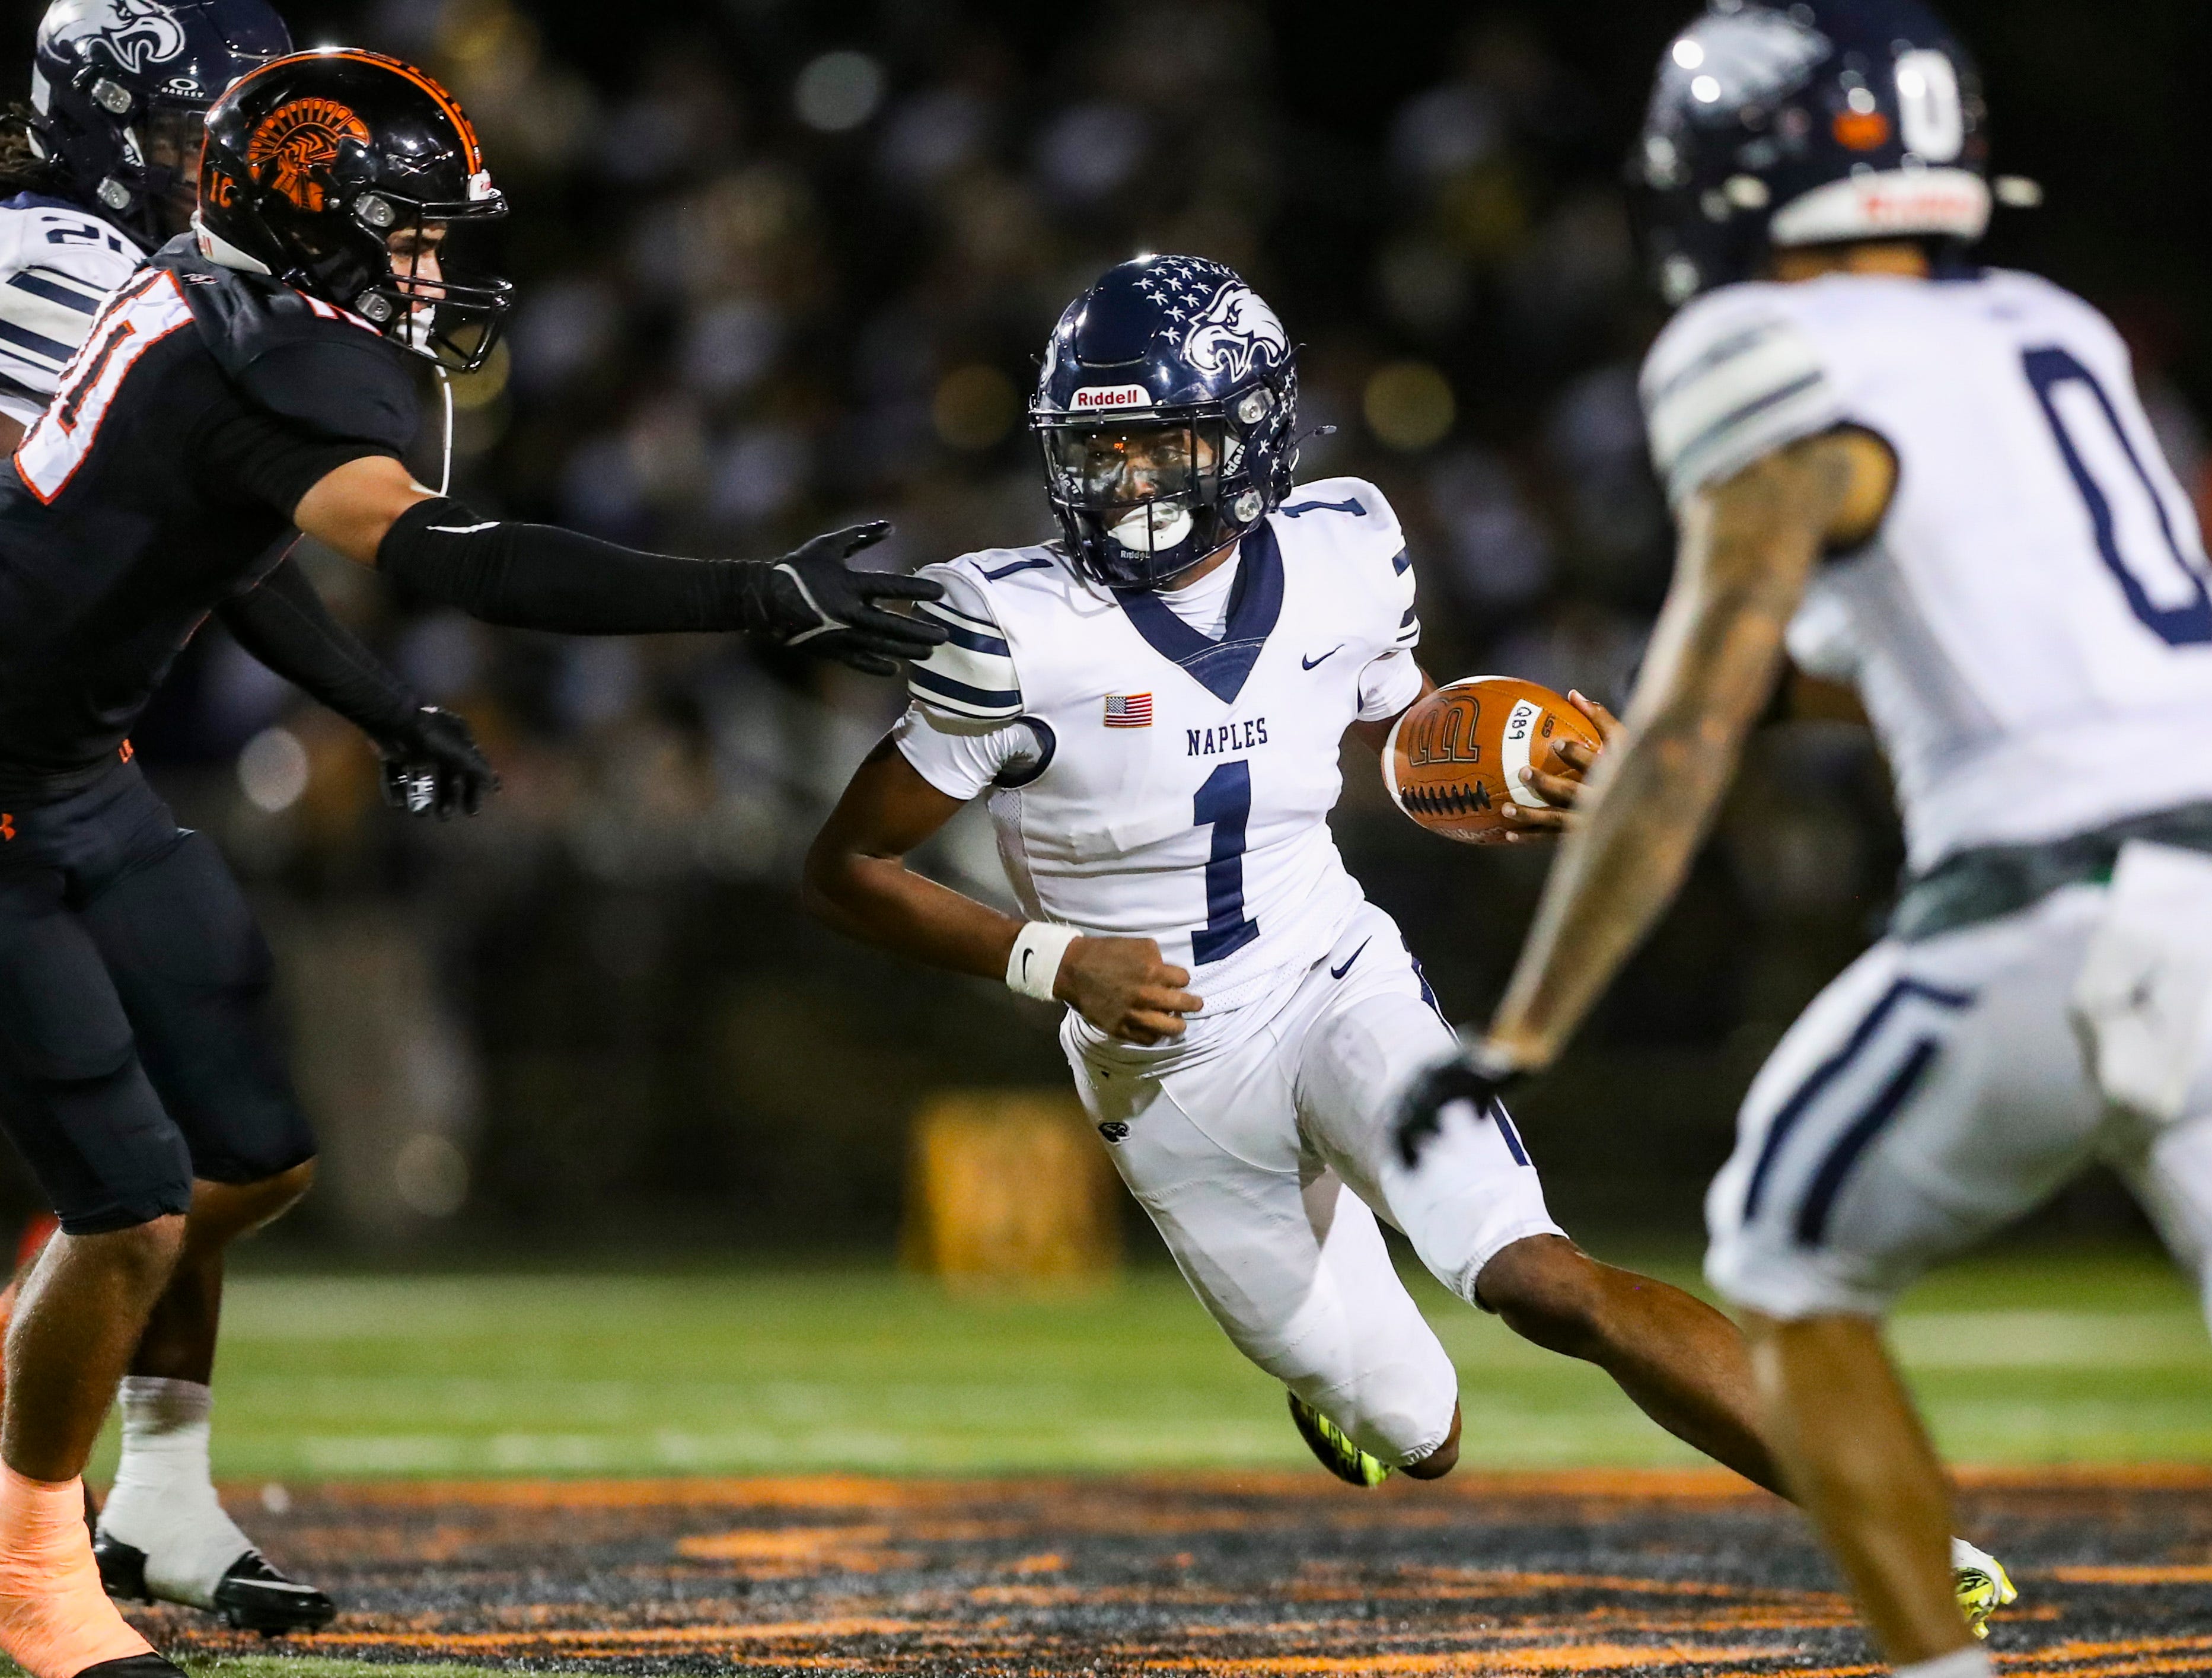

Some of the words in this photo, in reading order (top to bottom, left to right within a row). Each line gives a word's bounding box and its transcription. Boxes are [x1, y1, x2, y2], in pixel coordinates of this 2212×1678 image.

[1896, 49, 1965, 162] 0
[1078, 390, 1137, 406] Riddell
[1279, 497, 1367, 518] 1
[2021, 346, 2212, 647] 0
[1187, 717, 1268, 756] NAPLES
[1191, 759, 1260, 966] 1
